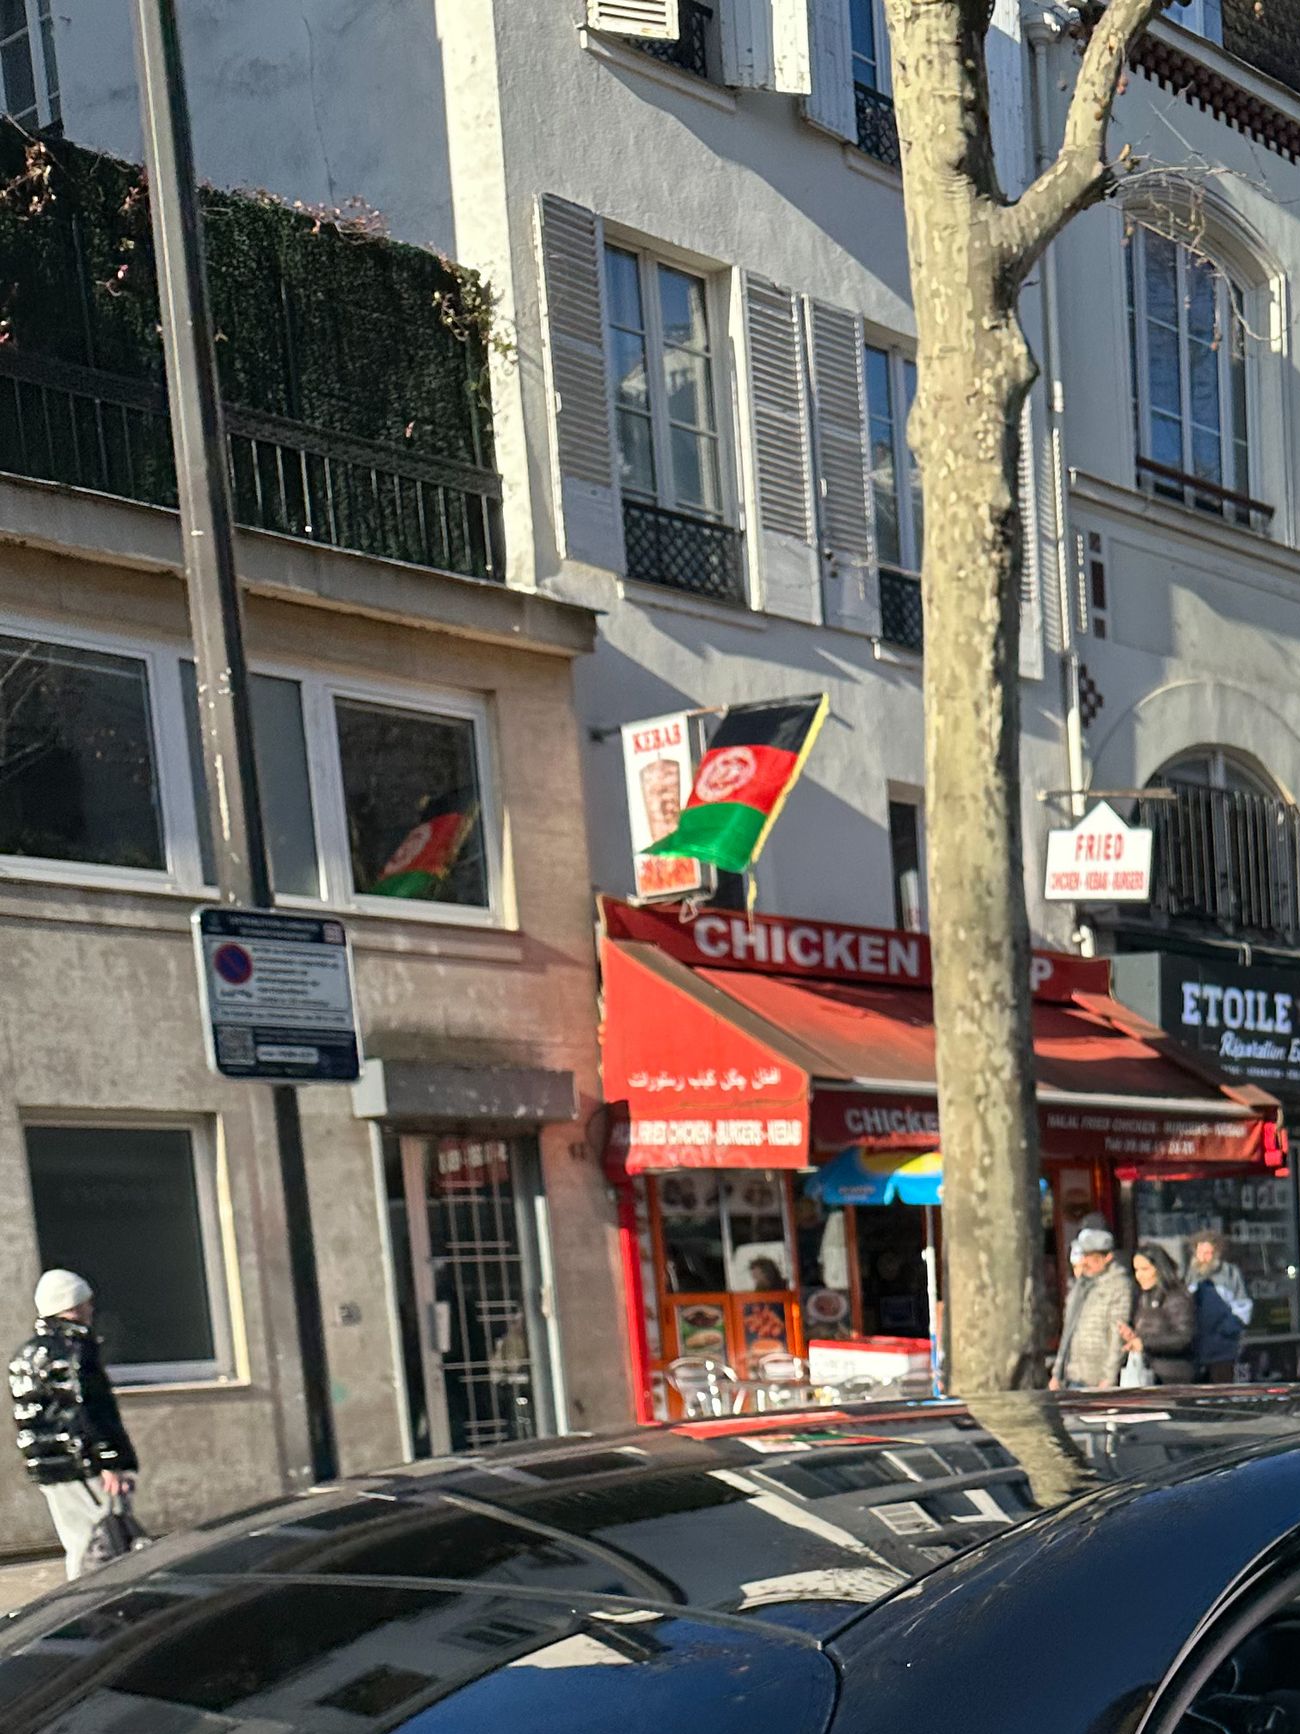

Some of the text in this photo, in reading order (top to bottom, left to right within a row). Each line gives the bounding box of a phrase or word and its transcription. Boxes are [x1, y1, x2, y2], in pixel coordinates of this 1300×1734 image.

[632, 723, 682, 754] KEBAB
[1075, 833, 1124, 862] FRIED
[693, 916, 921, 978] CHICKEN
[1181, 981, 1292, 1035] ETOILE
